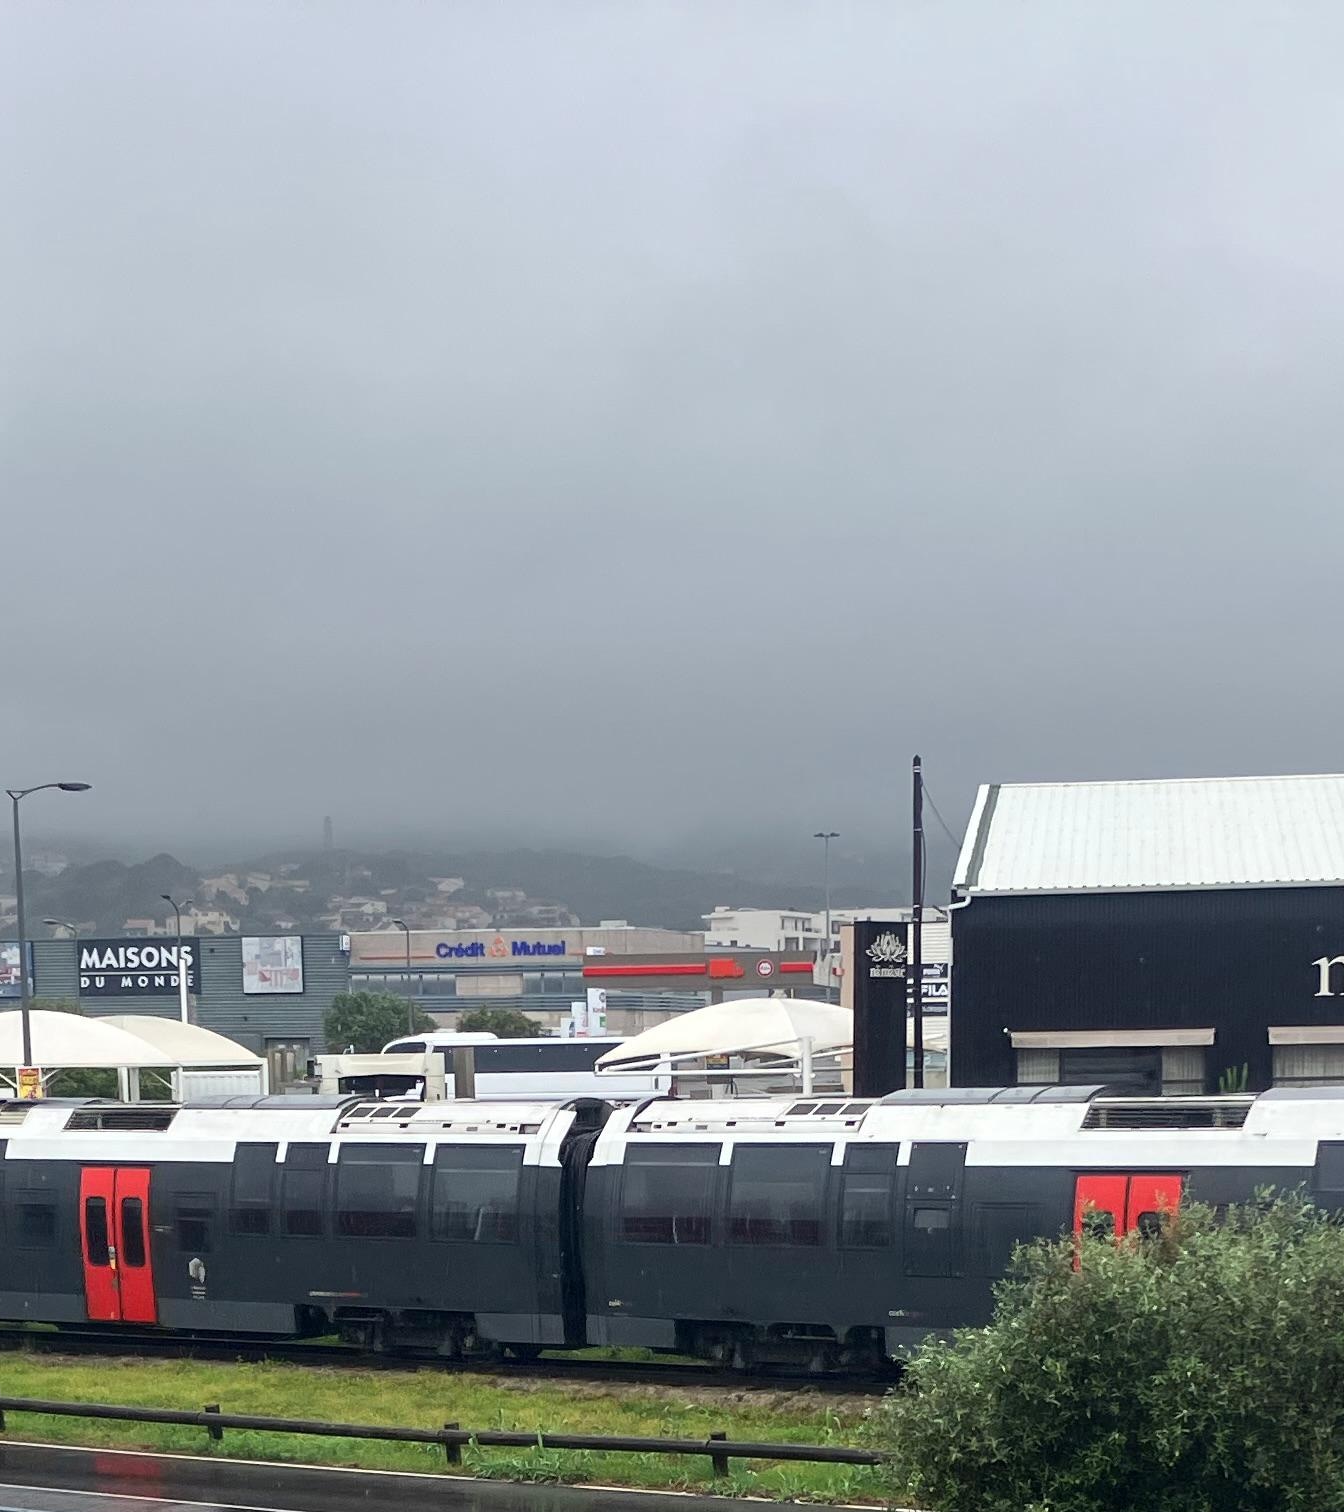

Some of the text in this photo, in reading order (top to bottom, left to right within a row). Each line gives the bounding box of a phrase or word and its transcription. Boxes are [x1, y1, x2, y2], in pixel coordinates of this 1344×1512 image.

[436, 940, 566, 957] Crédit Mutuel
[80, 945, 193, 968] MAISONS
[80, 975, 194, 988] DU MONDE
[921, 985, 948, 996] FILA
